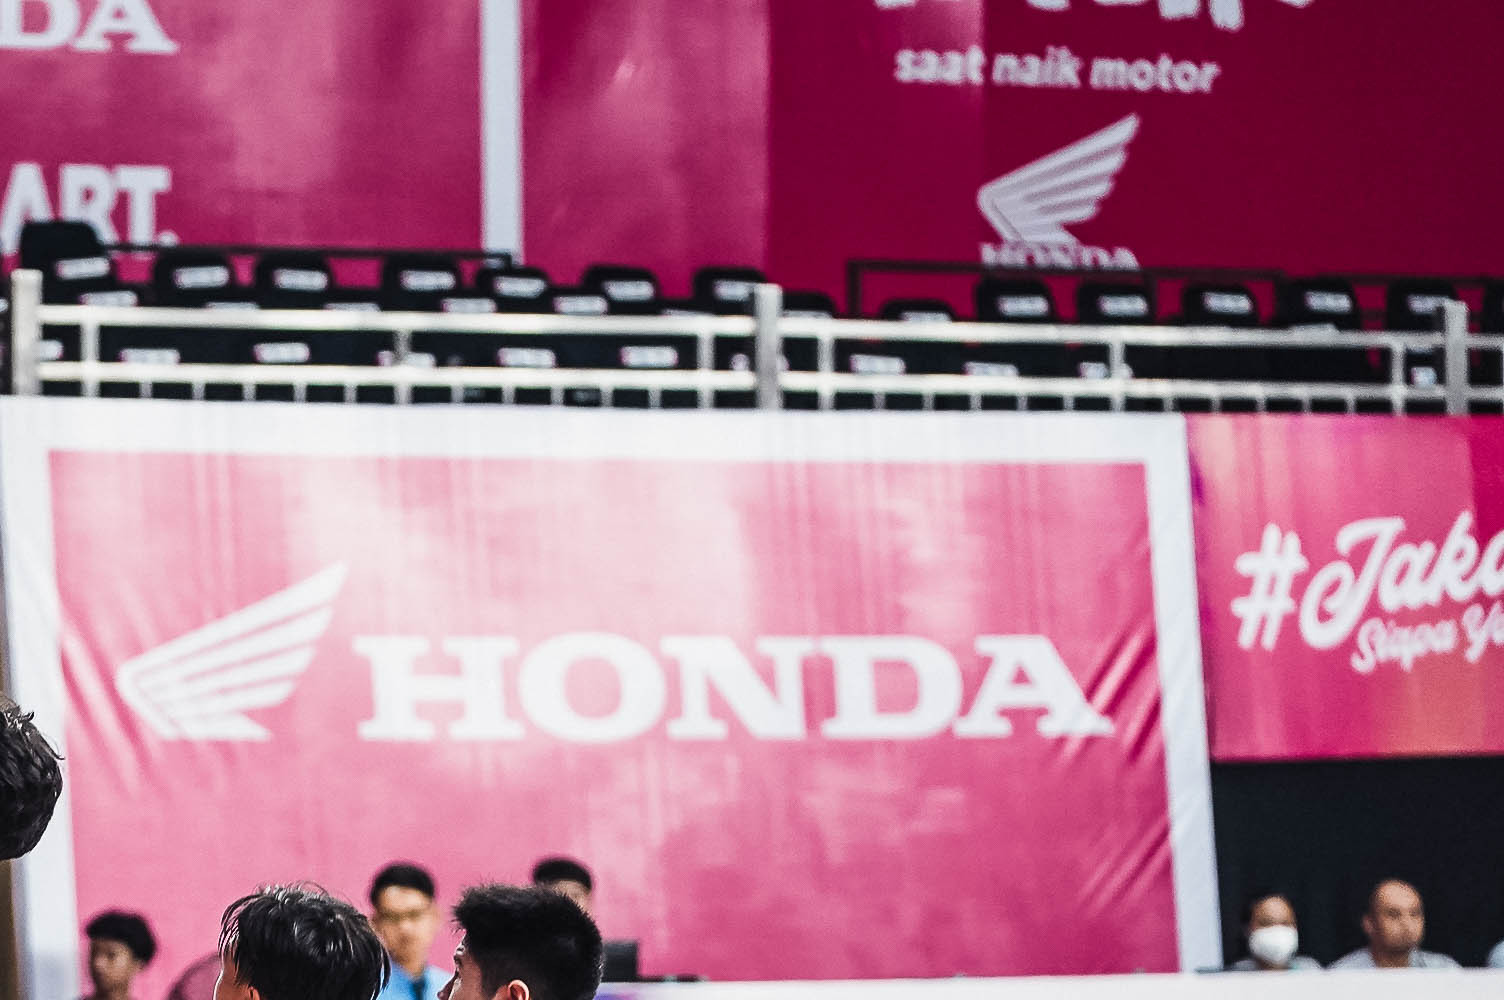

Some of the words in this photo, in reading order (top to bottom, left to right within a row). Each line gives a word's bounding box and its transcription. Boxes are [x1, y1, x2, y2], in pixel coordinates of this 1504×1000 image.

[895, 45, 984, 84] saat
[993, 46, 1083, 87] naik
[1090, 53, 1222, 93] motor
[352, 632, 1114, 744] HONDA
